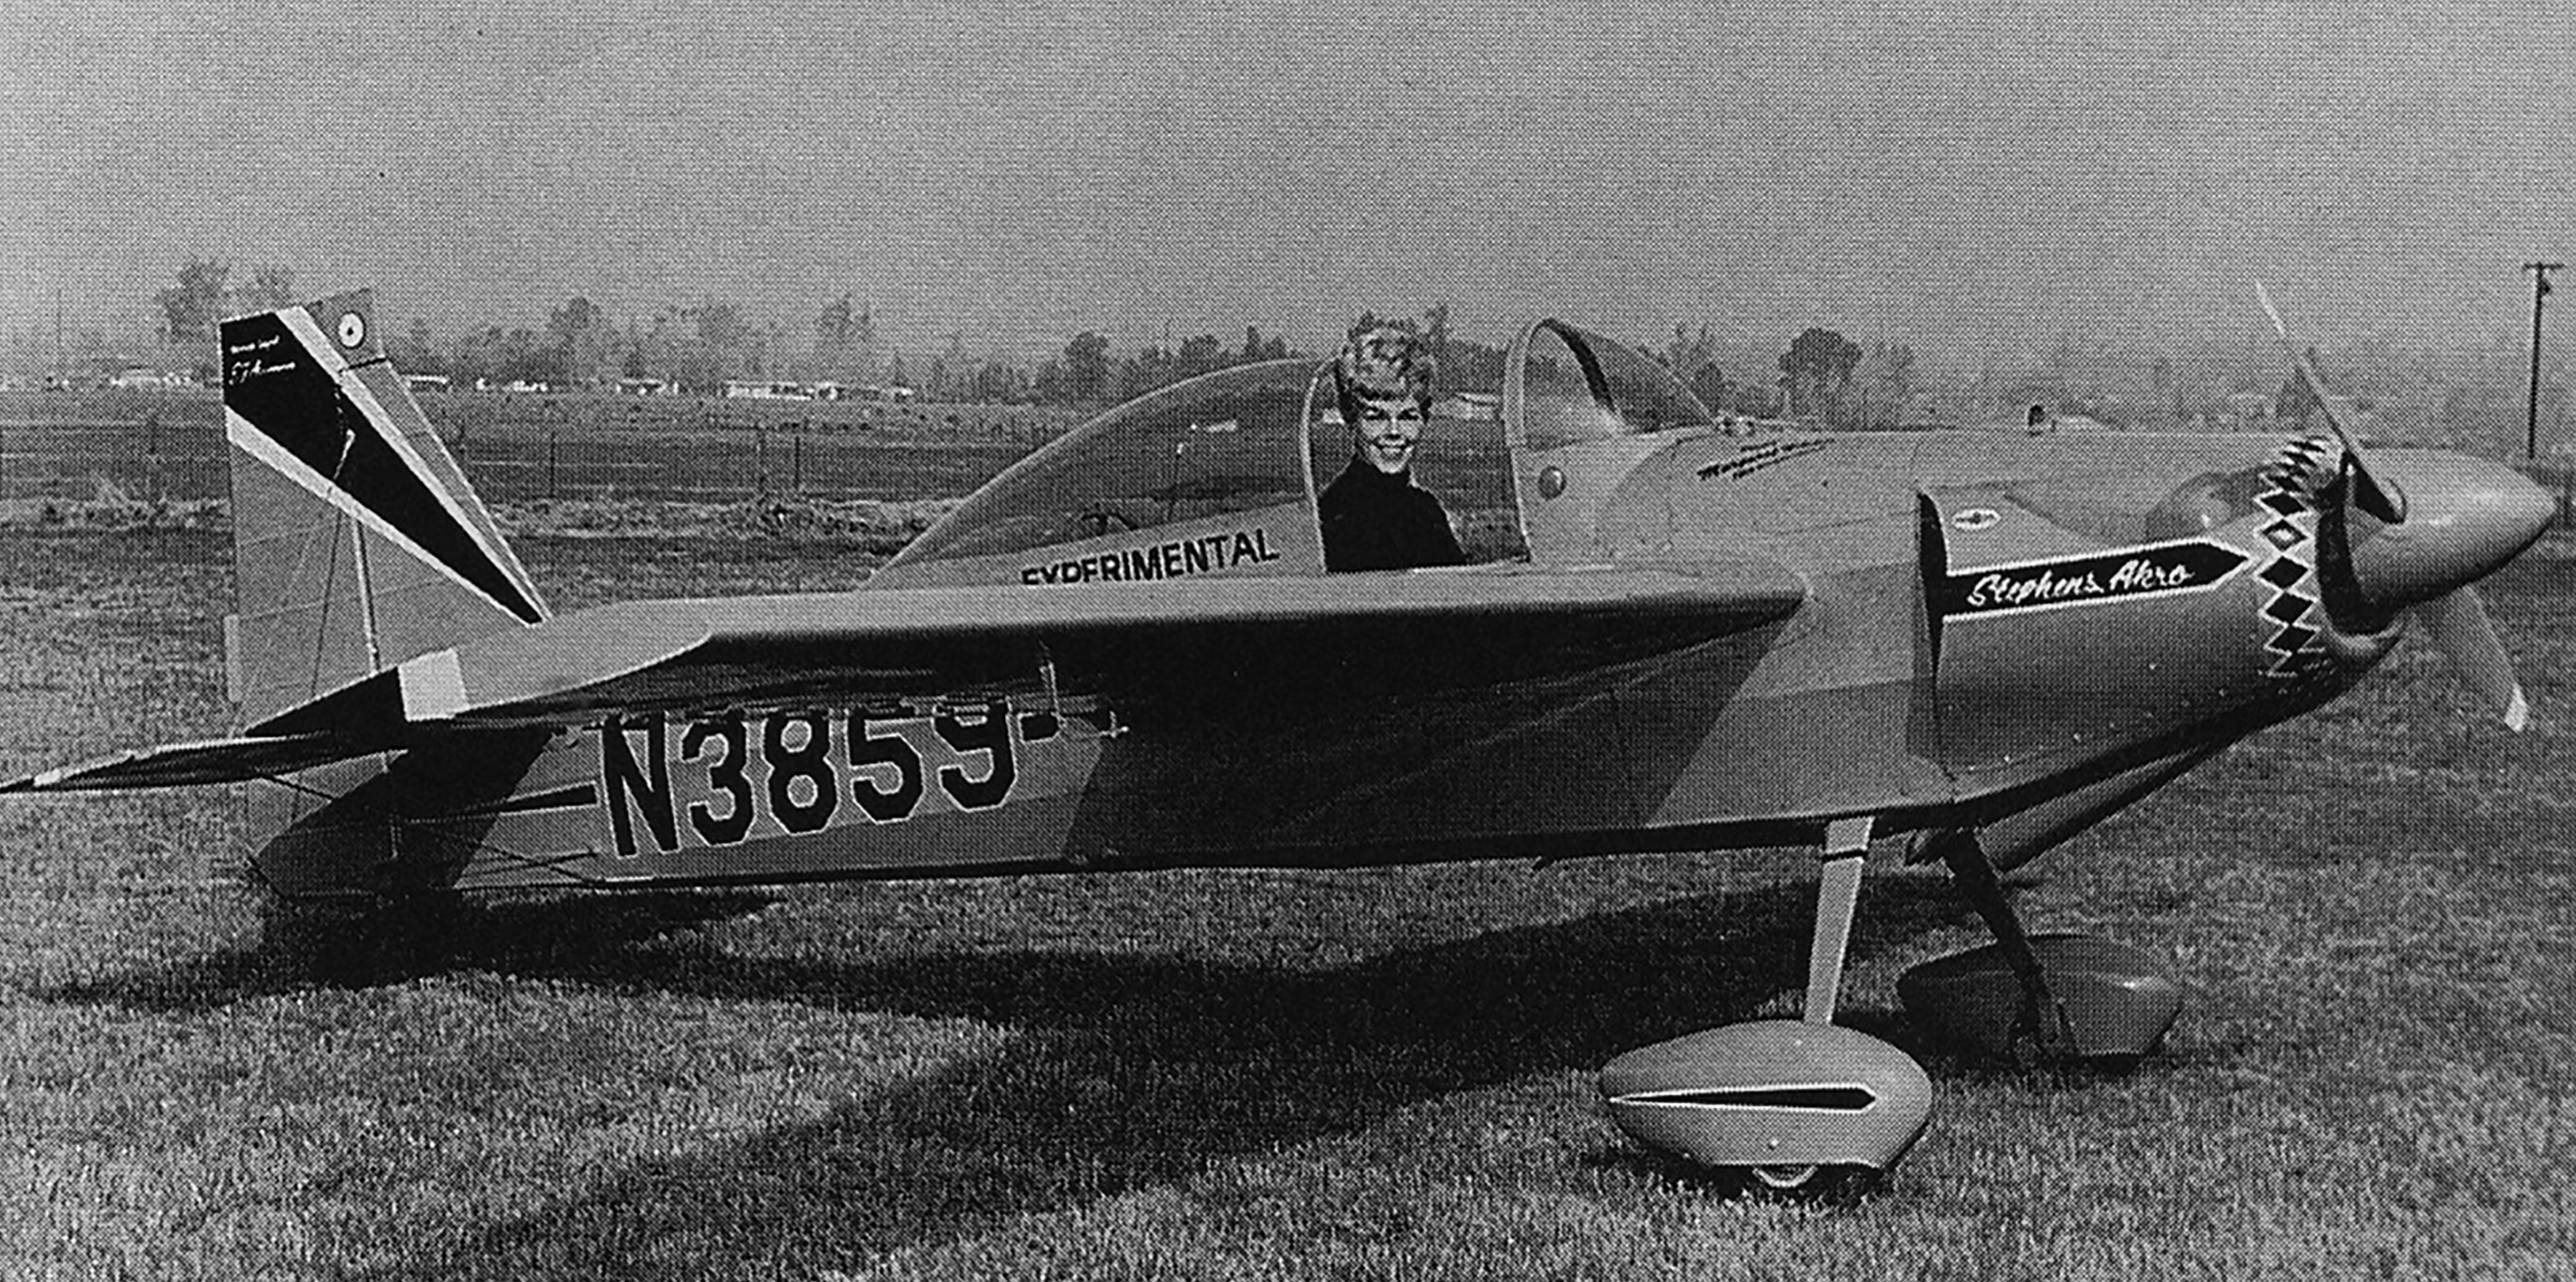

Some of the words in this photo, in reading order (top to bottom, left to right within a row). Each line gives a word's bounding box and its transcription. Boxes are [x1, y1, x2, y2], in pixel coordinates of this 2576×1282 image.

[1021, 528, 1280, 586] EXPERIMENTAL
[1966, 570, 2104, 608] Stephens
[2108, 559, 2196, 592] Akro
